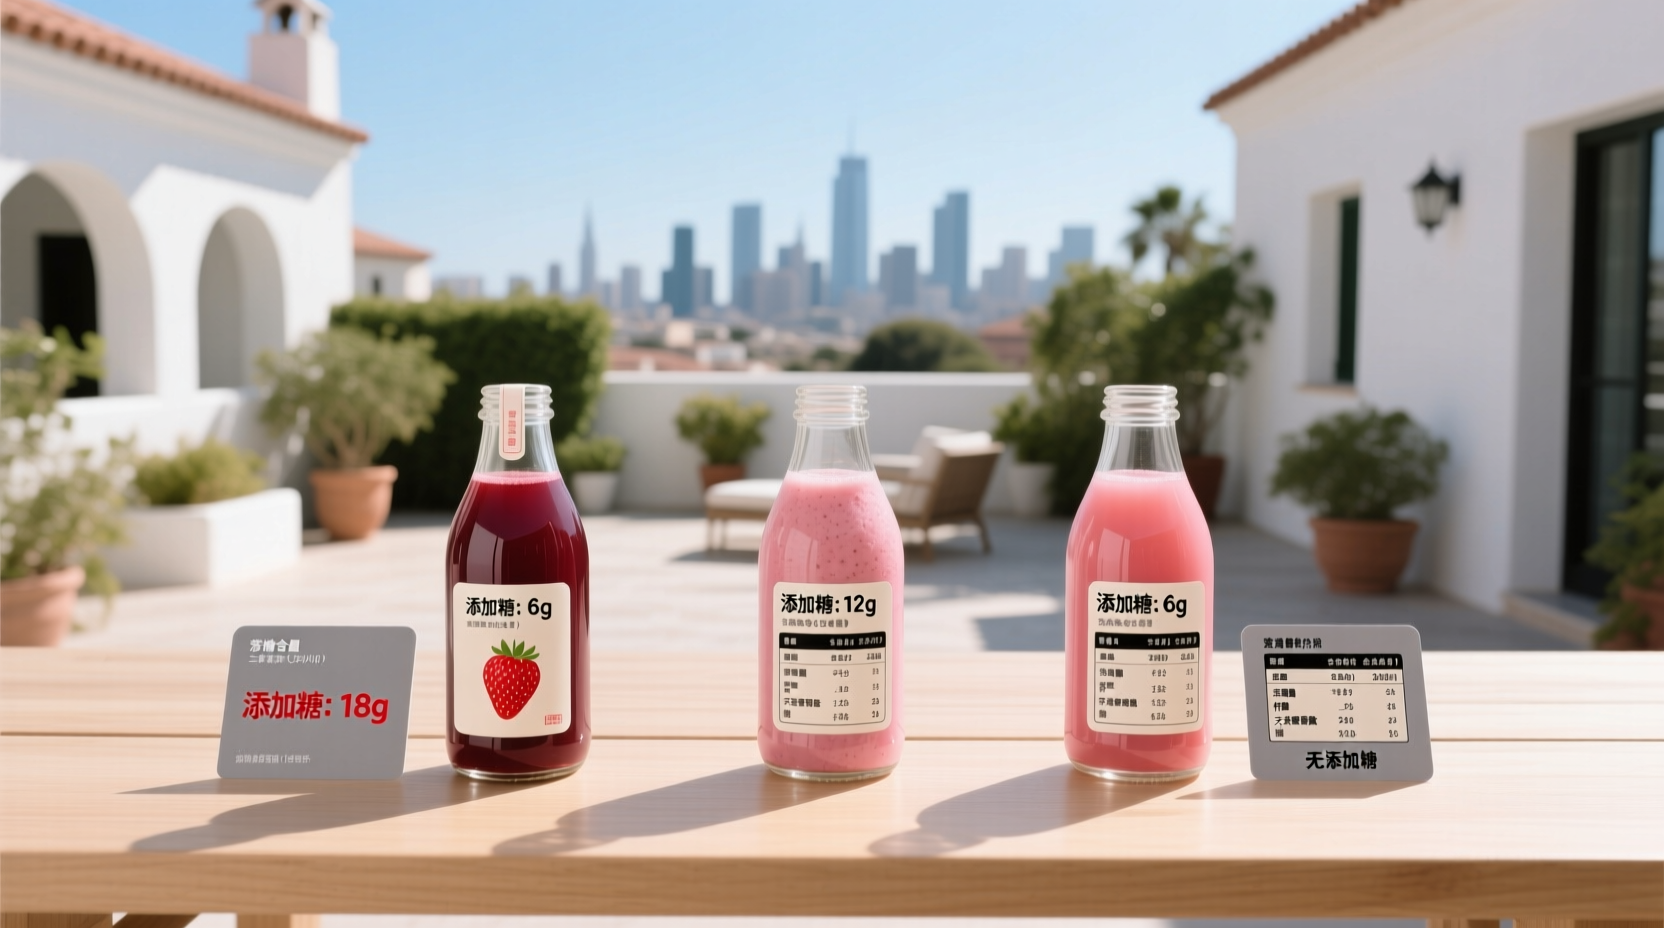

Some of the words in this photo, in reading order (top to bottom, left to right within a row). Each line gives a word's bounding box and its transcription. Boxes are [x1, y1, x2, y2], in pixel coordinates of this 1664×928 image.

[527, 597, 552, 620] 6g
[844, 594, 877, 617] 12g
[1163, 594, 1188, 618] 6g
[340, 692, 389, 724] 18g
[1305, 750, 1378, 770] 无添加糖
